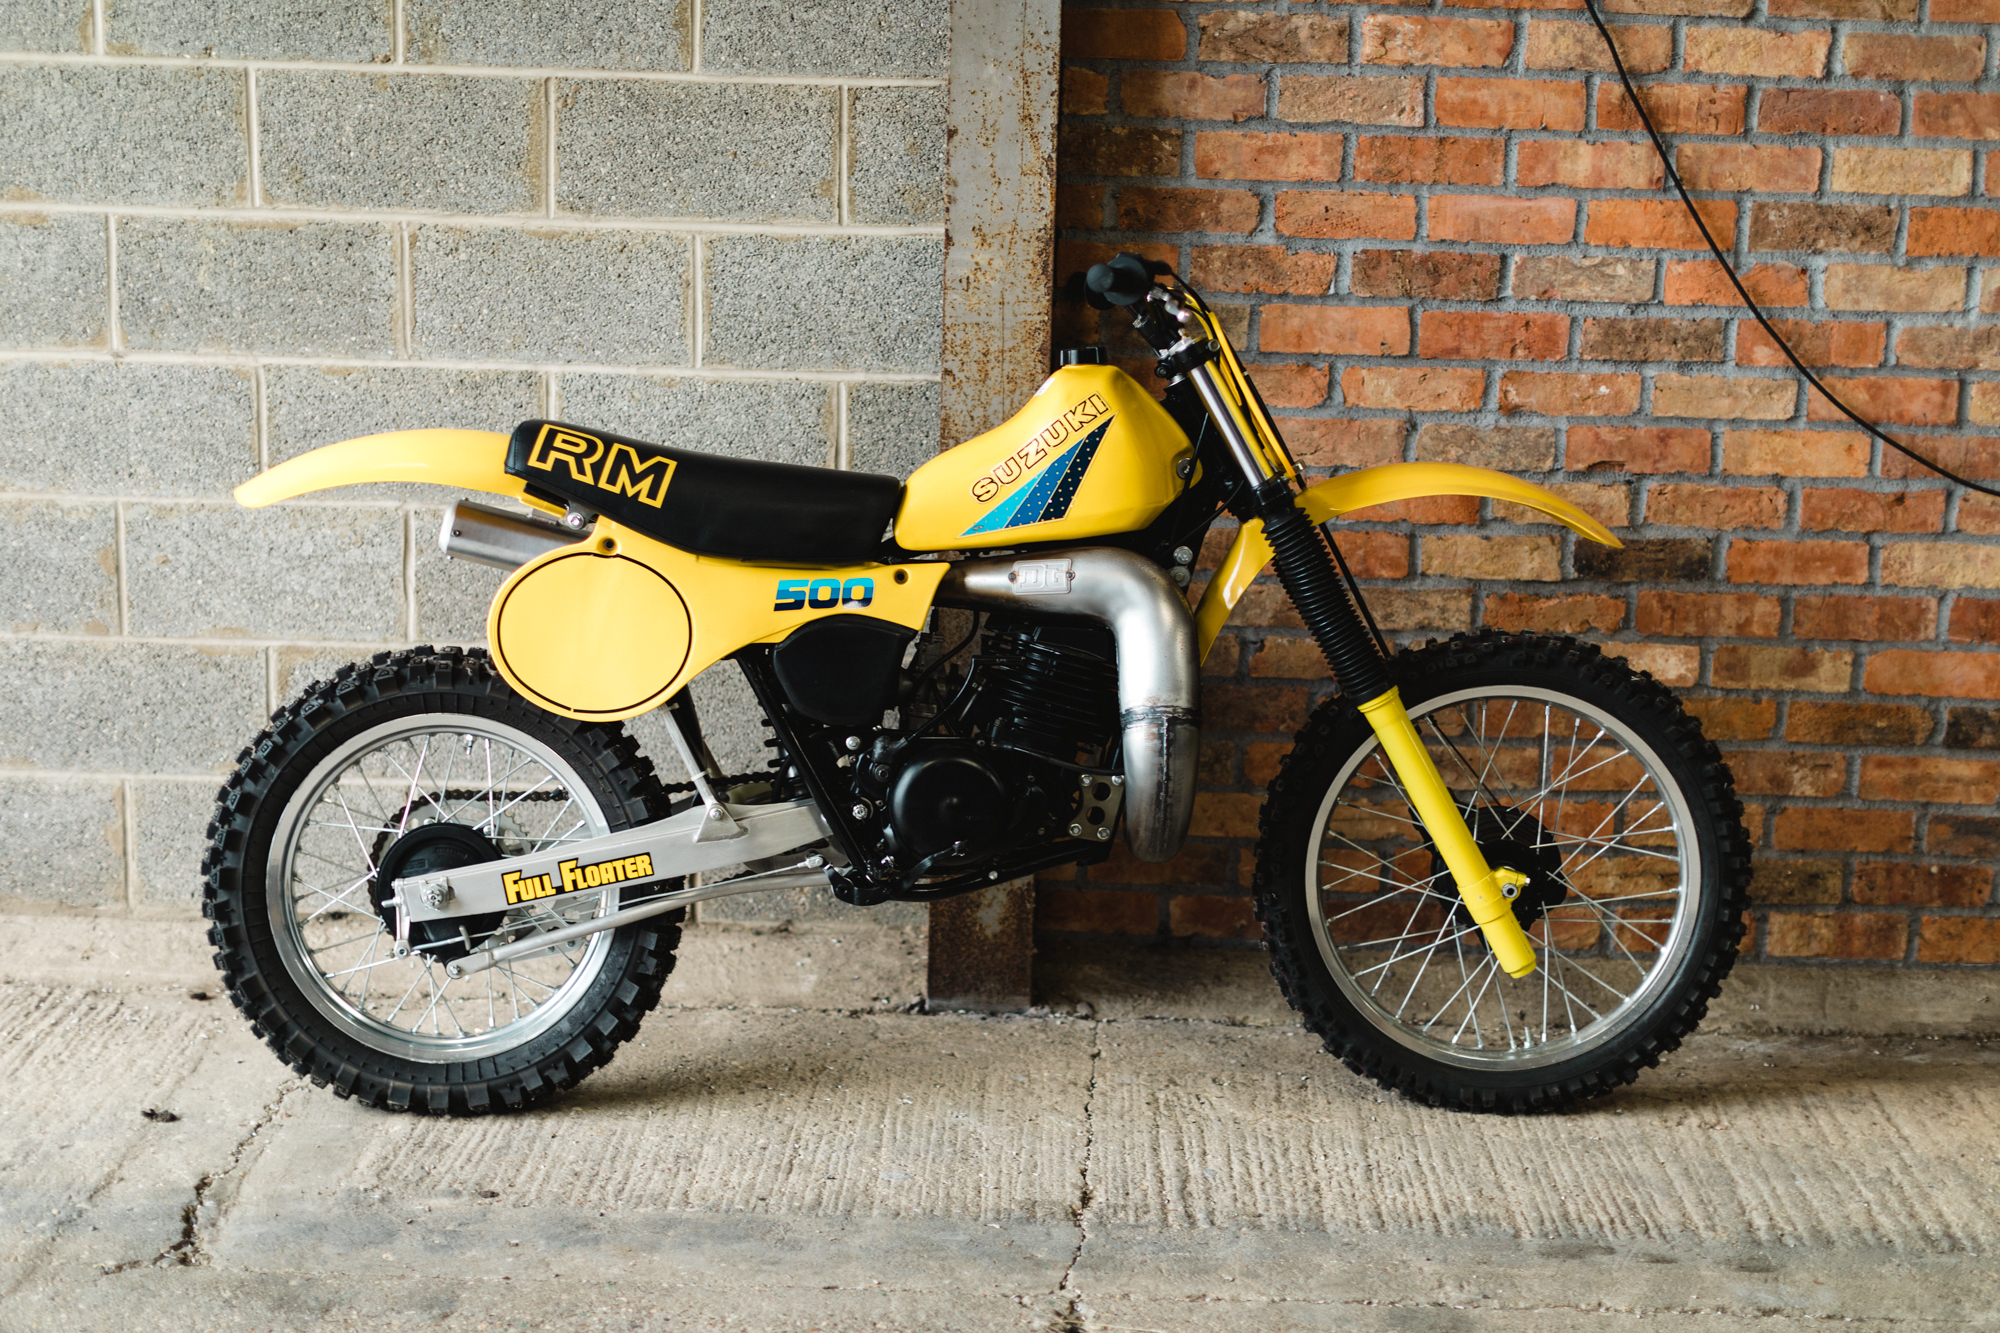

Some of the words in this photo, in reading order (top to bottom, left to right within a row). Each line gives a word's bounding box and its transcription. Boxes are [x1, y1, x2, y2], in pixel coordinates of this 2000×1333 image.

[527, 423, 677, 509] RM
[971, 393, 1111, 503] SUZUKI
[773, 577, 875, 611] 500
[1018, 563, 1066, 589] DG
[502, 870, 556, 905] FULL
[558, 852, 654, 892] FLOATER
